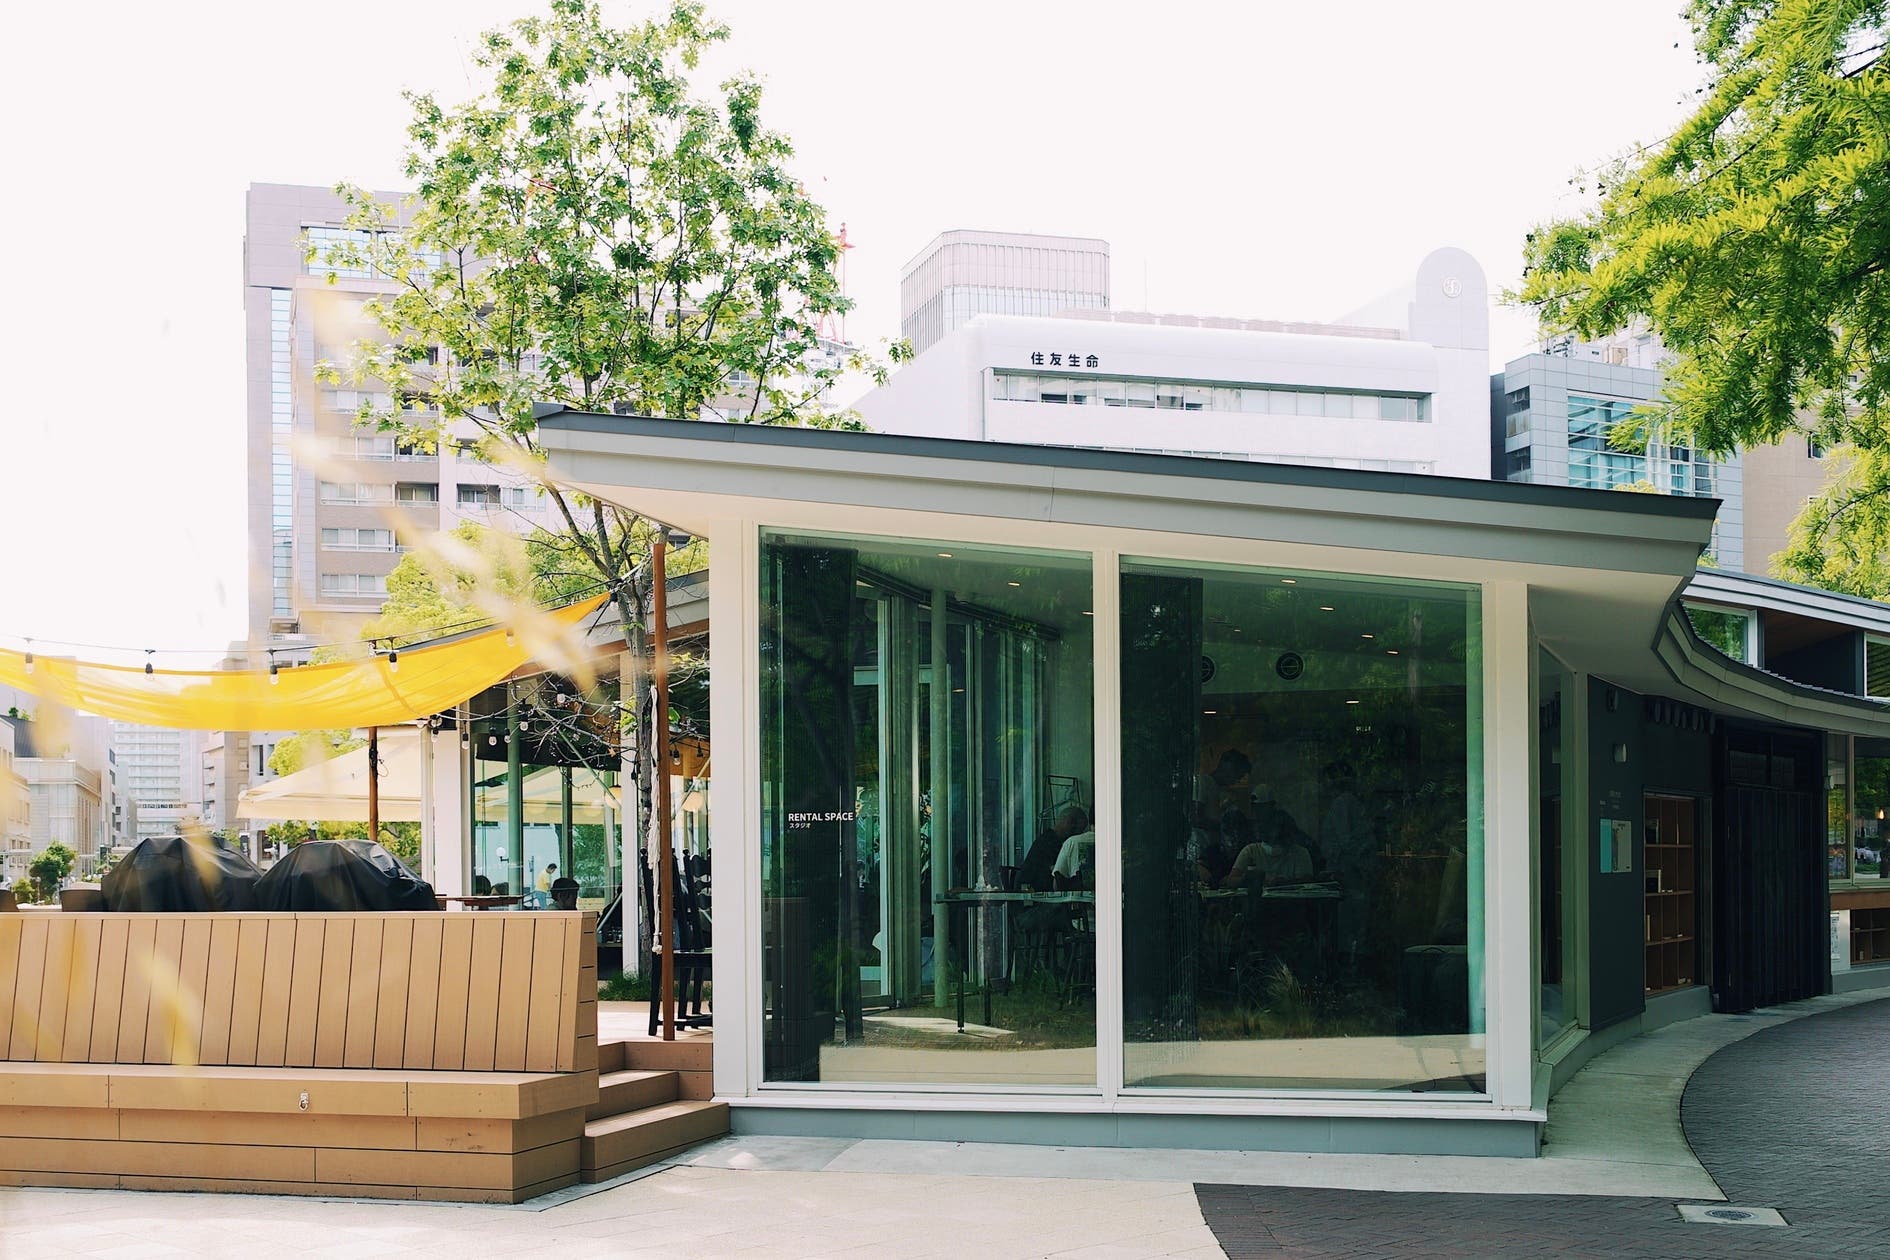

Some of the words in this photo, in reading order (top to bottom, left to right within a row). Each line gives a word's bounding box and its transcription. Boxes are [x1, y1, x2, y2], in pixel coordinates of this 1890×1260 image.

[1031, 351, 1099, 368] 住友生命
[788, 812, 823, 822] RENTAL
[824, 812, 854, 821] SPACE
